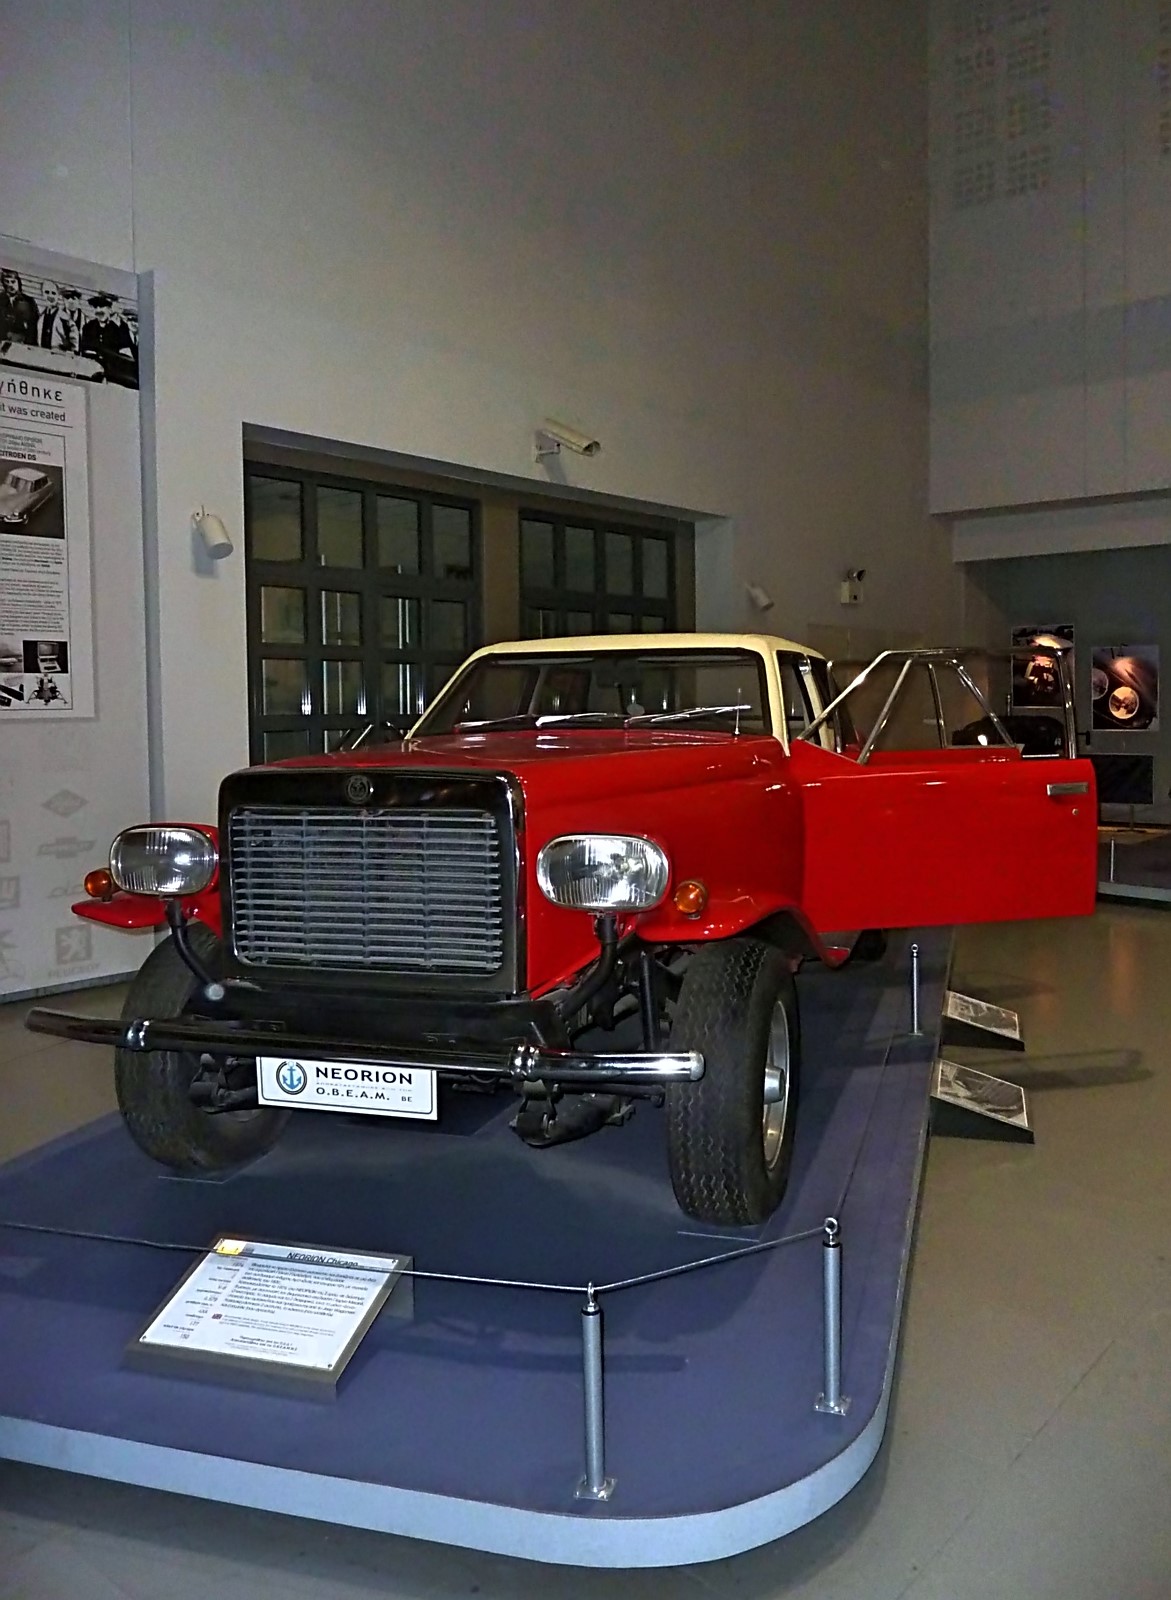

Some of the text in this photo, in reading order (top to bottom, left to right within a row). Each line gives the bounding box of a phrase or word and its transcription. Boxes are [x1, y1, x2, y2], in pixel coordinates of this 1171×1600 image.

[8, 405, 28, 416] was
[30, 408, 66, 422] created
[27, 453, 37, 461] DS
[315, 1067, 412, 1084] NEORION
[315, 1087, 413, 1103] O.B.E.A.M. BE
[286, 1252, 326, 1264] NEORION
